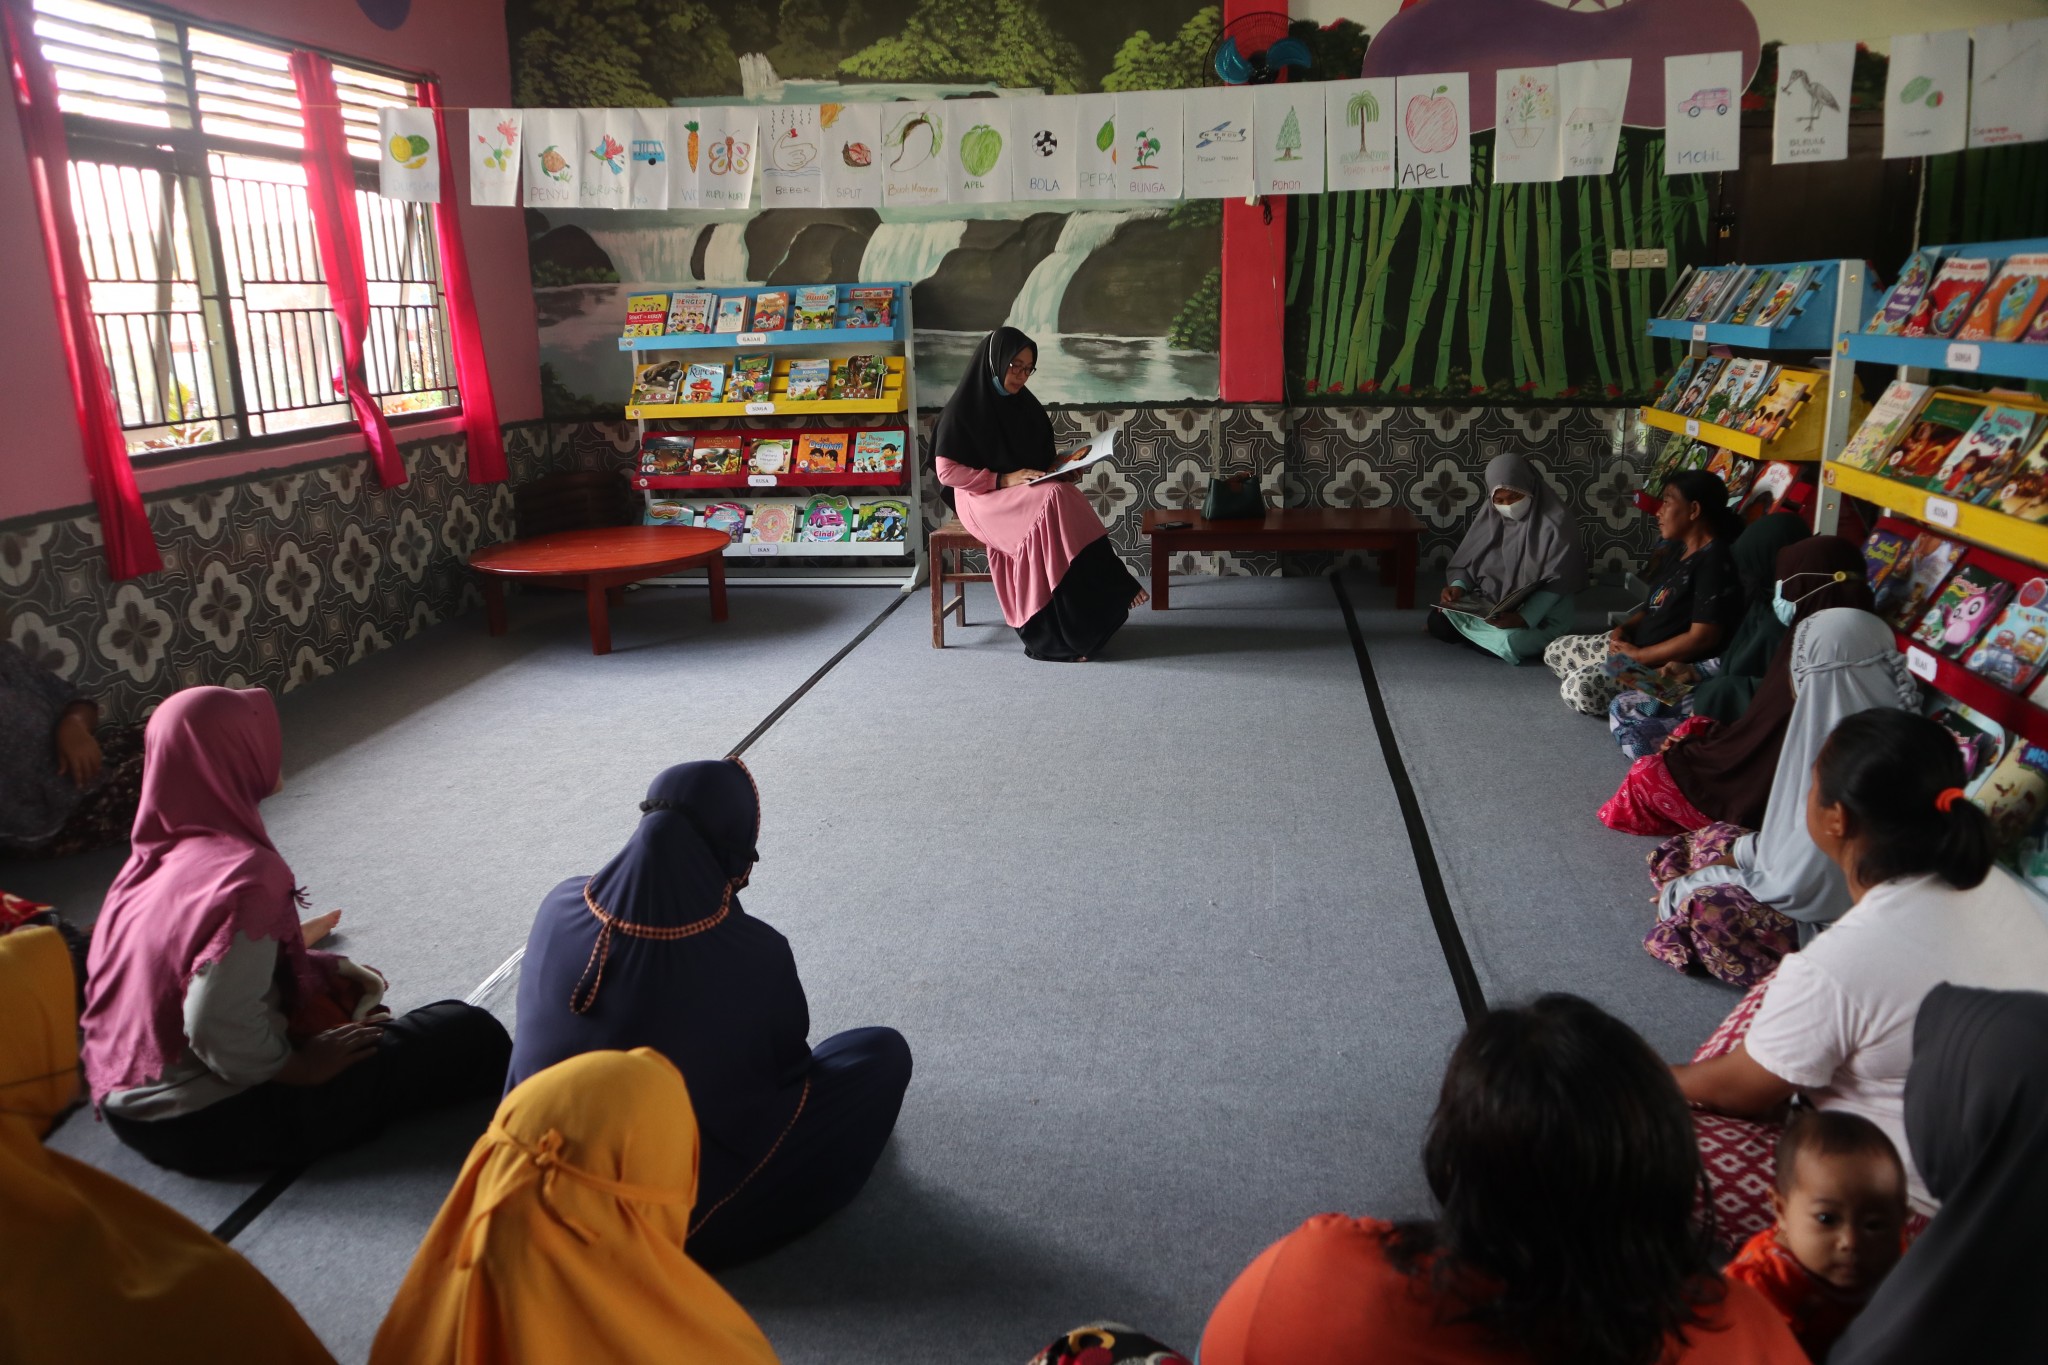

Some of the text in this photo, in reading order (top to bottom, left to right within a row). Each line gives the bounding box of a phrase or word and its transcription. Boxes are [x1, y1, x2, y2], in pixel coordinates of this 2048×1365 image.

[963, 180, 985, 189] APEL
[1029, 178, 1060, 192] BOLA
[1129, 181, 1166, 193] BUNGA
[530, 186, 569, 201] PENYU
[836, 187, 863, 199] SIPUT
